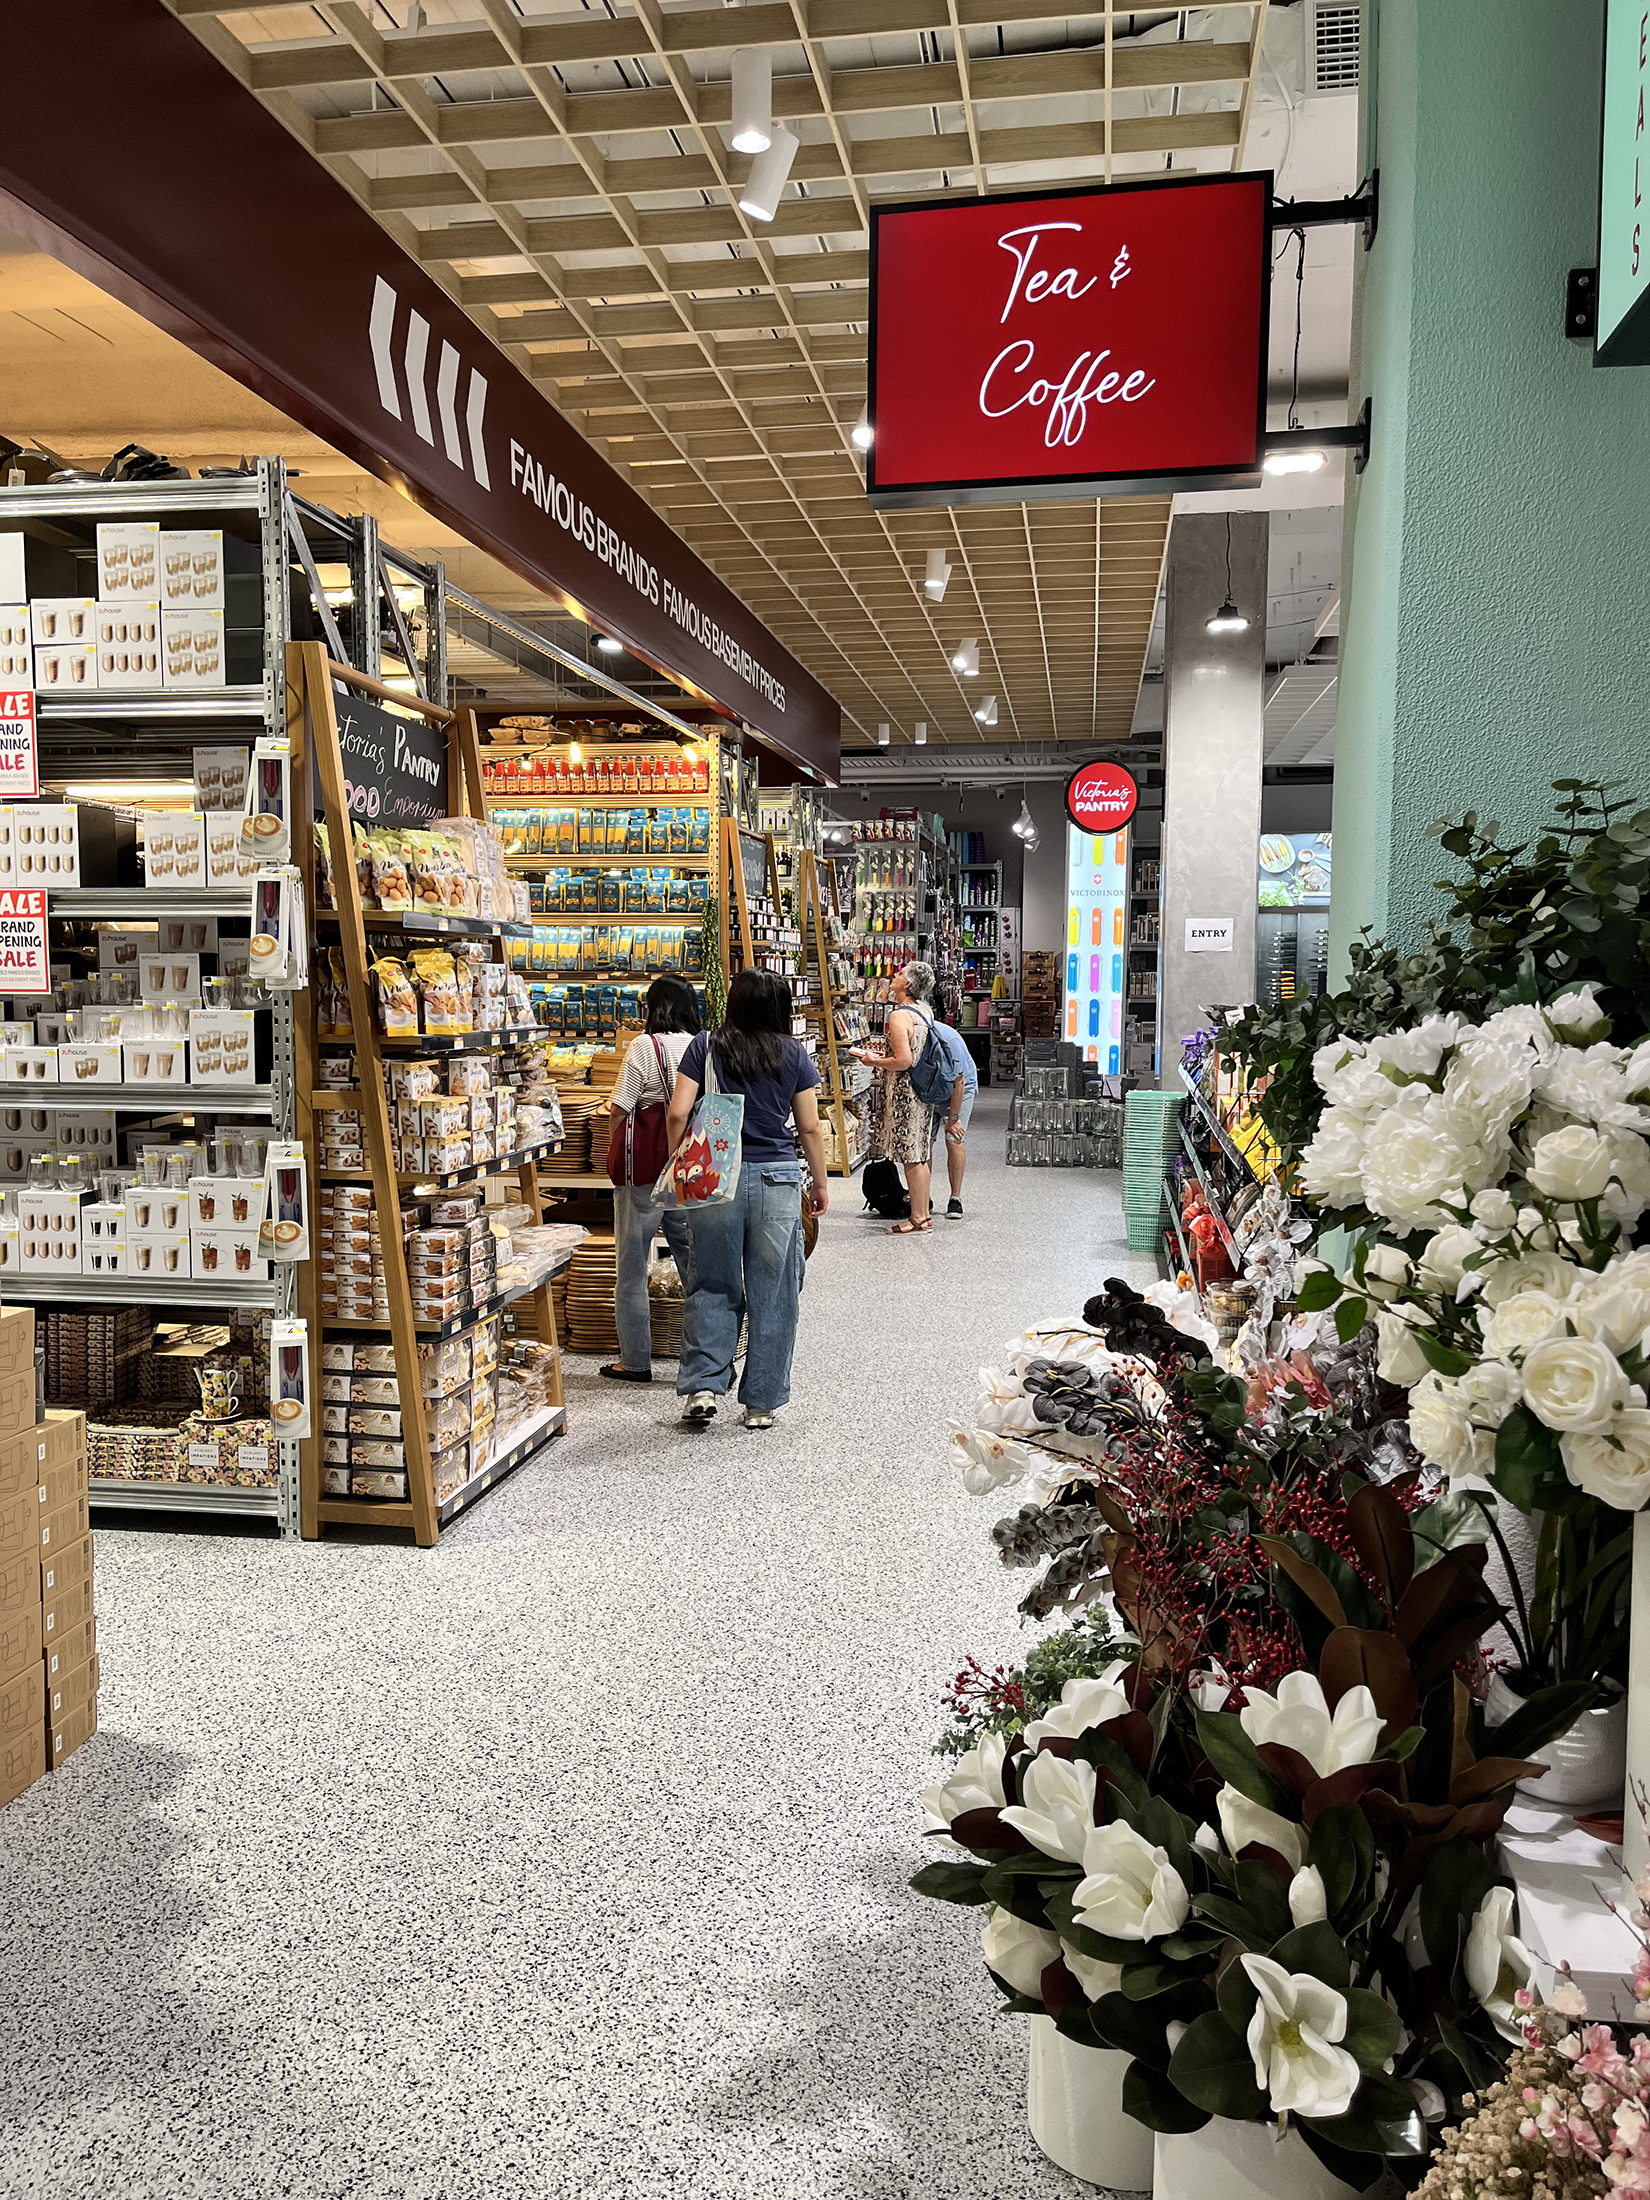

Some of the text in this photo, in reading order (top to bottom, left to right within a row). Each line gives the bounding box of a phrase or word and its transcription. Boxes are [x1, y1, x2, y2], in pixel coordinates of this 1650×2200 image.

[1631, 0, 1649, 276] EALS
[998, 222, 1131, 324] Tea &
[979, 340, 1156, 447] Coffee
[510, 437, 786, 713] FAMOUS BRANDS FAMOUS BASEMENT PRICES
[0, 693, 30, 716] LE
[1074, 779, 1132, 801] Victoria's
[1075, 801, 1129, 812] PANTRY
[1070, 889, 1125, 897] VICTORINOX
[1191, 929, 1227, 938] ENTRY
